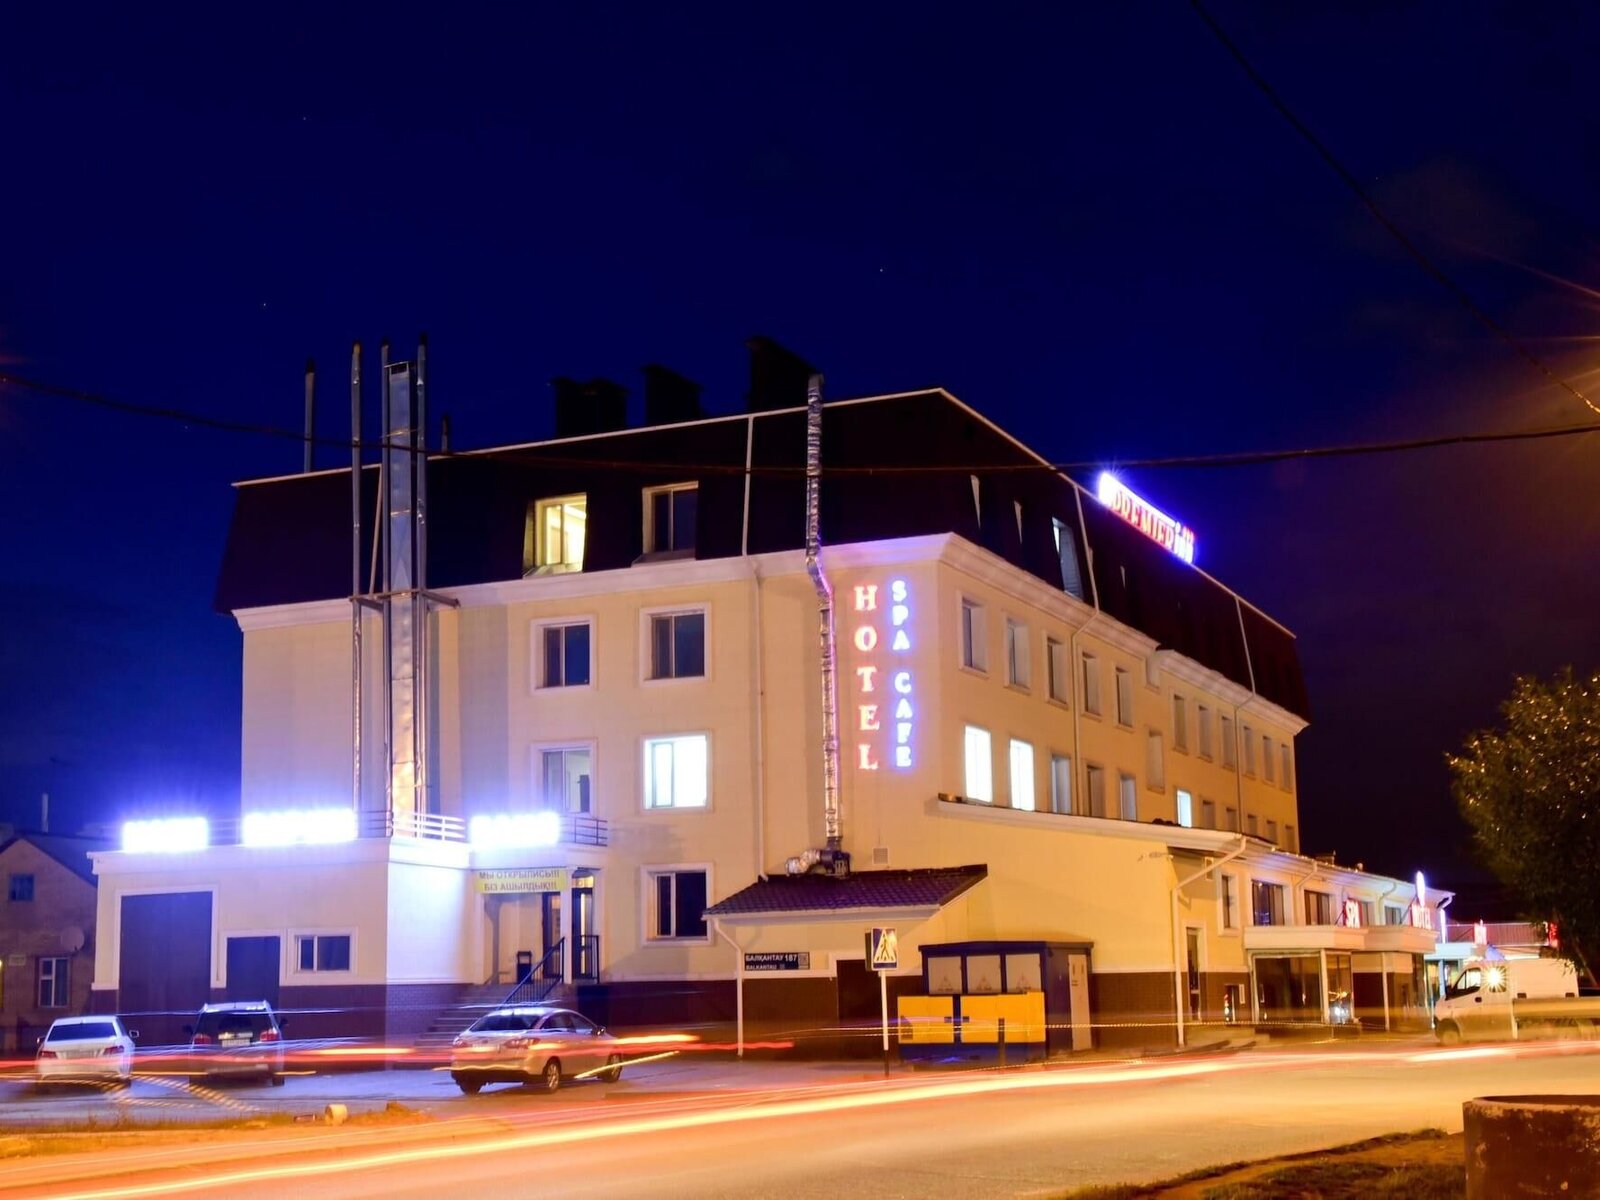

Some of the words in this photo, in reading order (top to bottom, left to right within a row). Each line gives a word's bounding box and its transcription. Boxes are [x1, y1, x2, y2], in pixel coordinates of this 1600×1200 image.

[892, 580, 910, 650] SPA
[854, 585, 880, 770] HOTEL
[894, 672, 913, 767] CAFE
